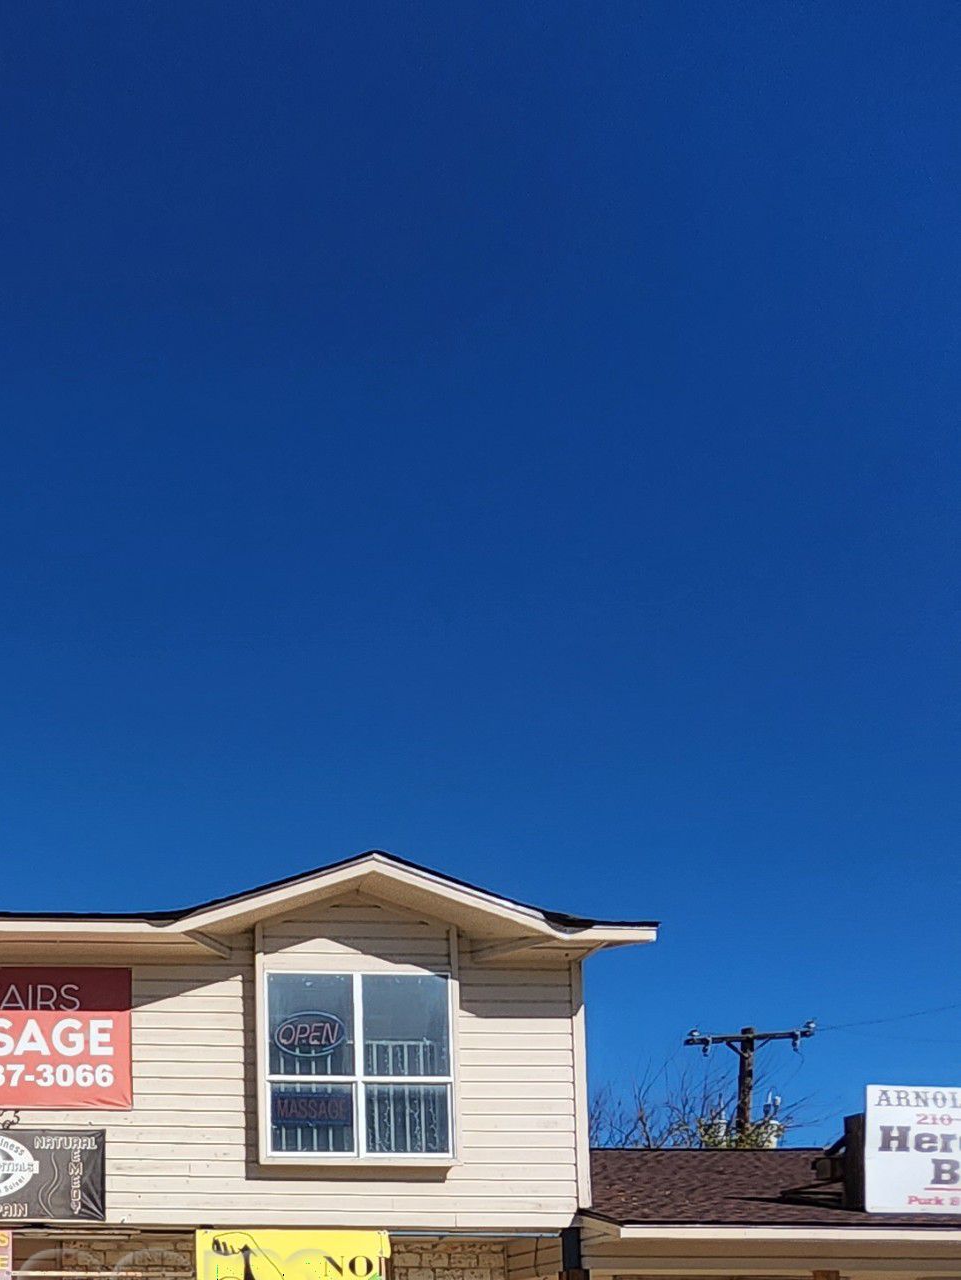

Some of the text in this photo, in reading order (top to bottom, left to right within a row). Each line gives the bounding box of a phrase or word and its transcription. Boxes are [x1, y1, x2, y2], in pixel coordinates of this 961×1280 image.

[278, 1022, 339, 1046] OPEN
[33, 1135, 98, 1150] NATURAL
[878, 1125, 961, 1153] Her
